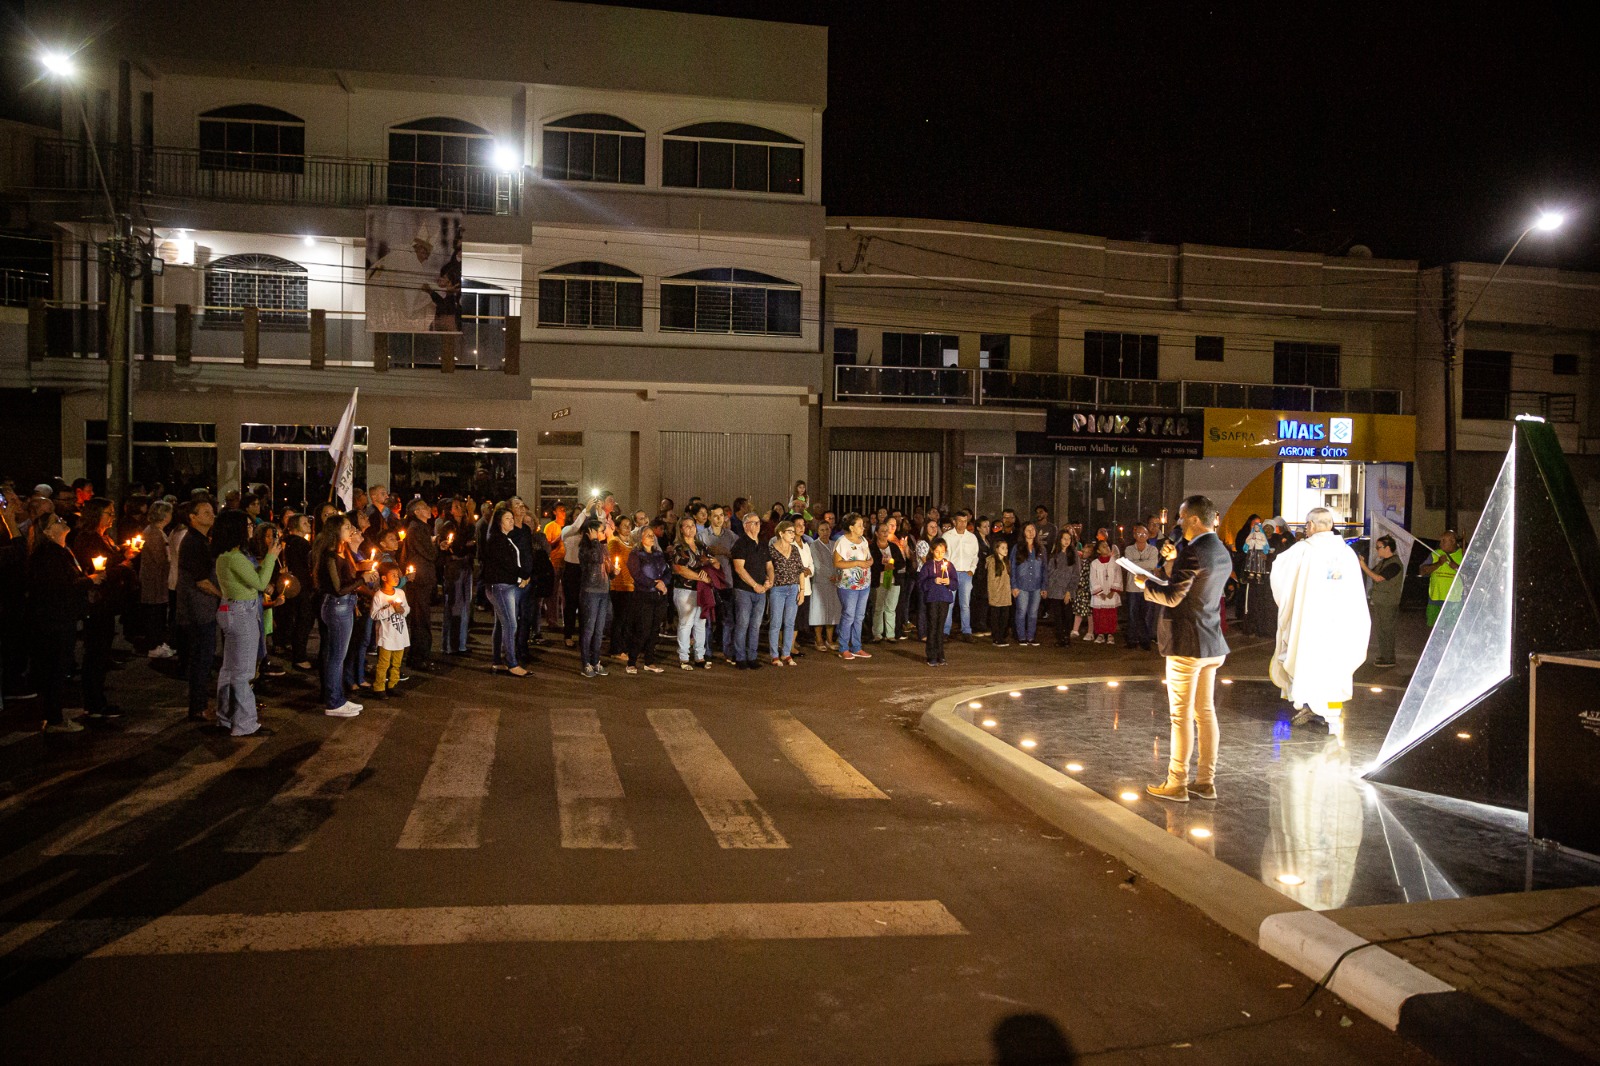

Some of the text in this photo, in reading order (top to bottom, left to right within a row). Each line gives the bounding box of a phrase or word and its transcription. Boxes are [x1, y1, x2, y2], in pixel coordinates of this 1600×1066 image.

[1072, 413, 1190, 436] PINK STAR
[1278, 420, 1325, 440] MAIS
[1221, 431, 1256, 442] SAFRA
[1054, 442, 1138, 454] Homem Mulher Kids
[1279, 445, 1348, 457] AGRONEÓCIOS
